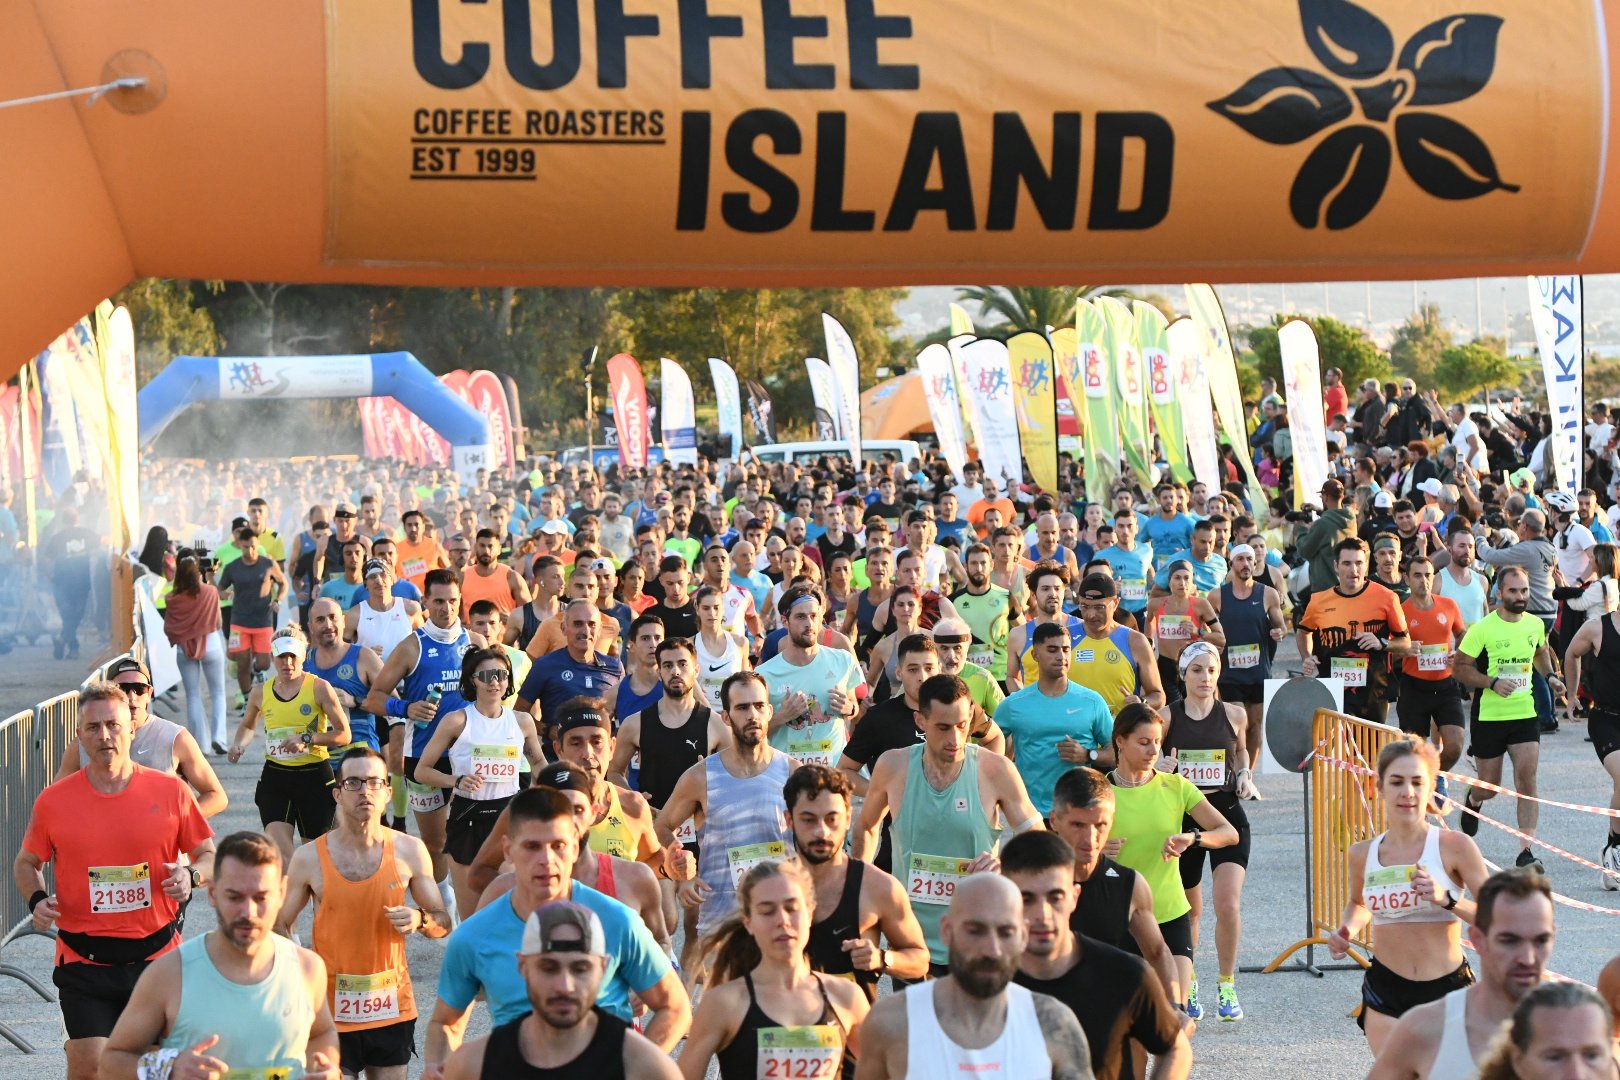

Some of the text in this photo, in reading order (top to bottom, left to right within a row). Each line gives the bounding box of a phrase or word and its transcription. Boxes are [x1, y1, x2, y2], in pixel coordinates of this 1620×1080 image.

[411, 0, 919, 90] COFFEE
[414, 108, 665, 136] COFFEE ROASTERS
[412, 147, 536, 173] EST 1999
[676, 108, 1175, 233] ISLAND
[1231, 655, 1257, 666] 21134
[475, 763, 515, 776] 21629
[1182, 767, 1220, 780] 21106
[409, 794, 440, 808] 21478
[95, 887, 146, 905] 21388
[1368, 891, 1419, 911] 21627
[340, 995, 392, 1015] 21594
[765, 1058, 833, 1079] 21222
